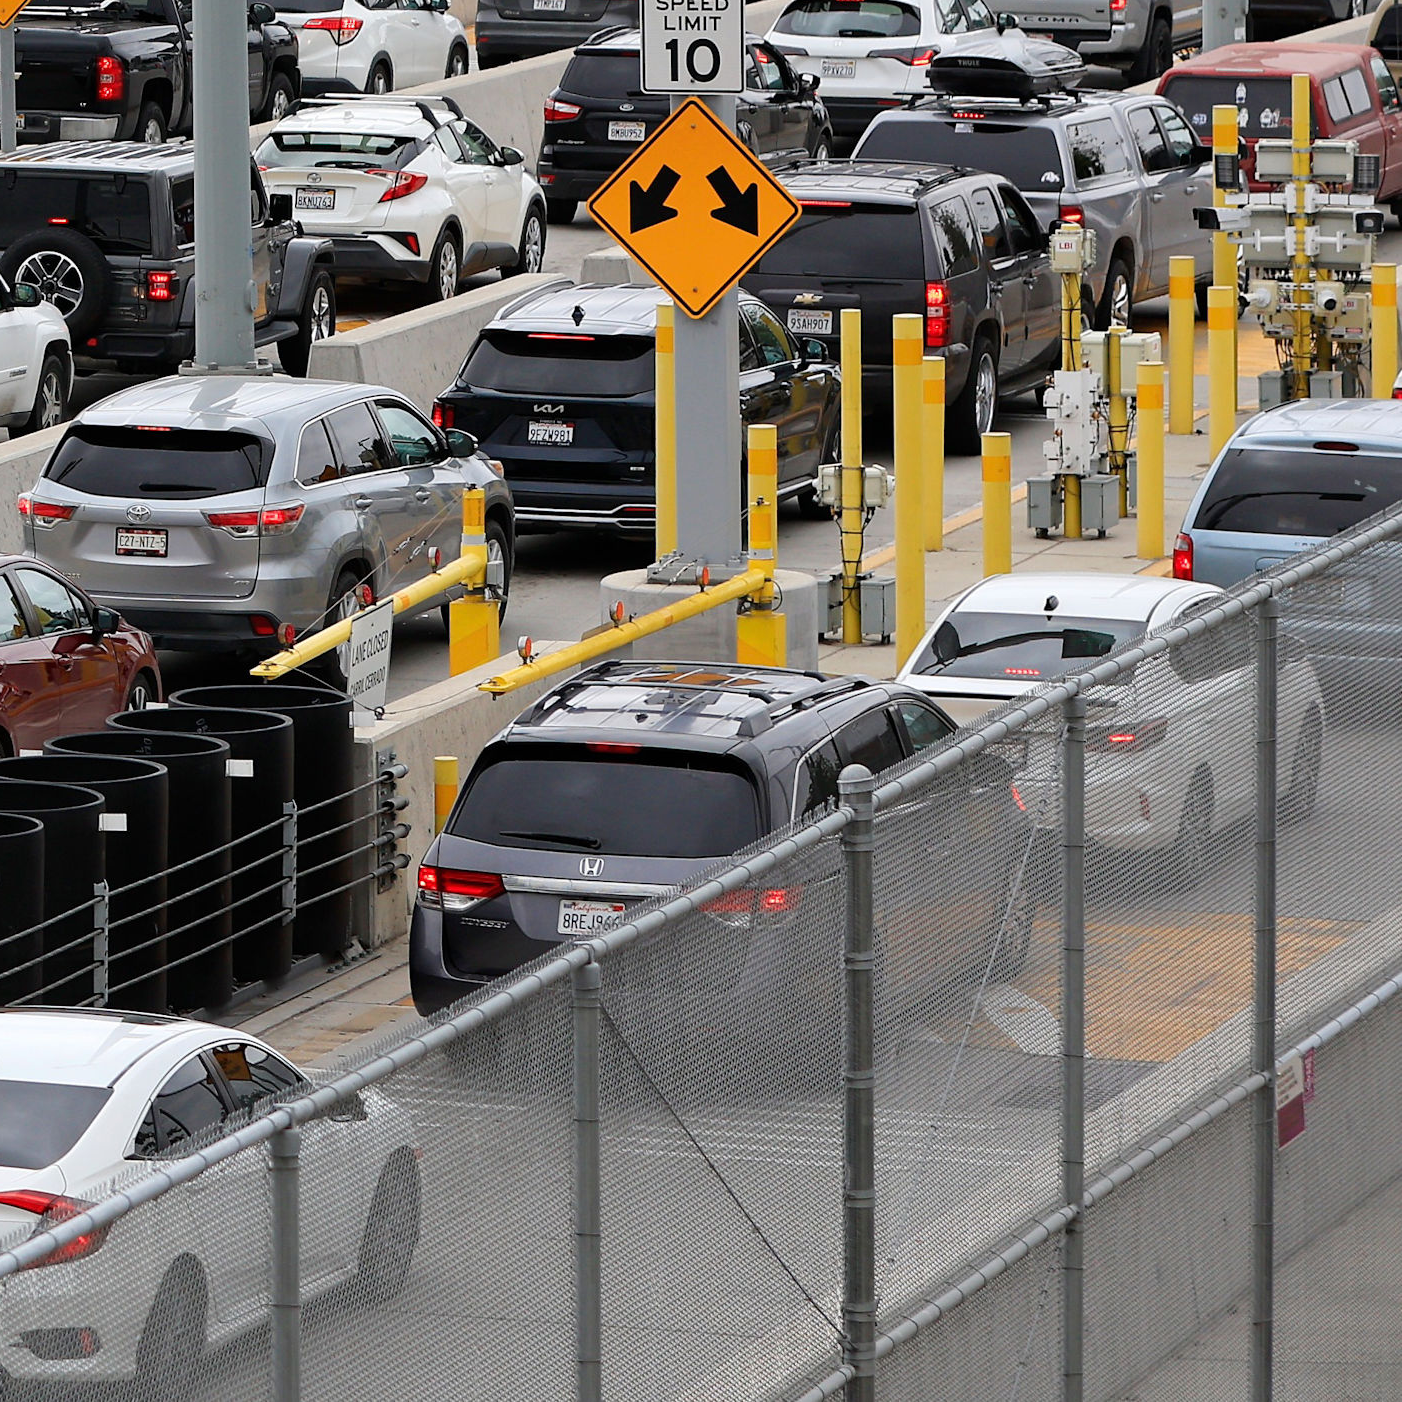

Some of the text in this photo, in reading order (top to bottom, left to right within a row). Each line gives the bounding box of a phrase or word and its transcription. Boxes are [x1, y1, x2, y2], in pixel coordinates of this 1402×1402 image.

[663, 16, 721, 31] LIMIT
[1024, 14, 1080, 24] COMA
[665, 38, 721, 83] 10
[298, 195, 333, 208] 8KNU763
[1059, 242, 1073, 250] LBI
[790, 317, 829, 330] 9SAH907
[351, 629, 389, 667] LANE CLOSED
[350, 666, 386, 698] CARRIL CERRADO
